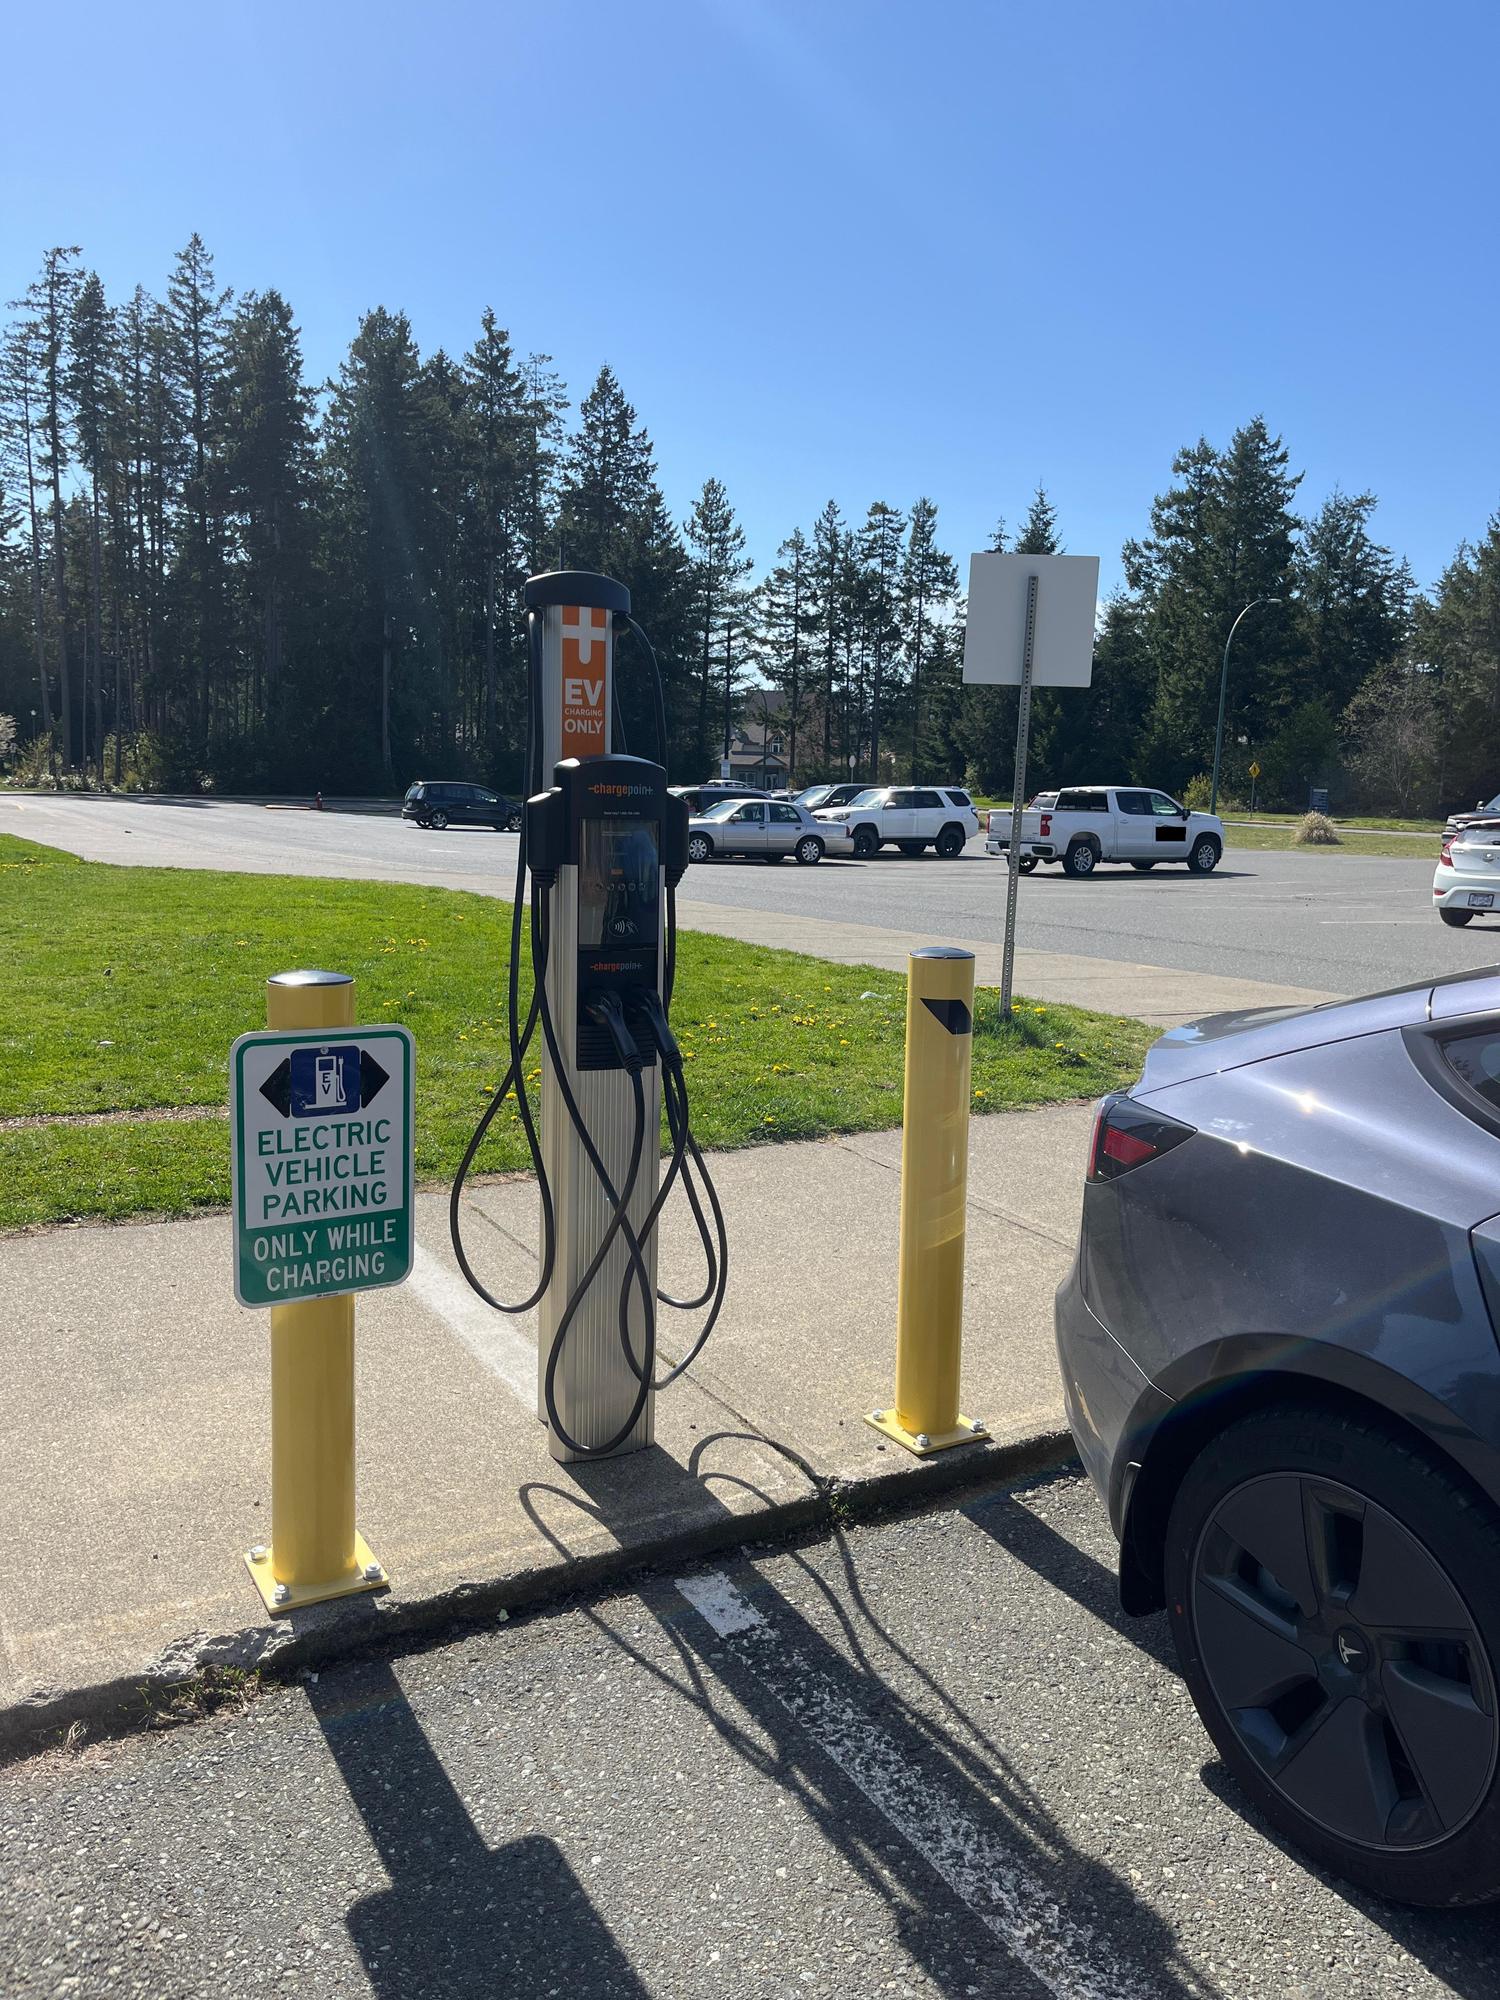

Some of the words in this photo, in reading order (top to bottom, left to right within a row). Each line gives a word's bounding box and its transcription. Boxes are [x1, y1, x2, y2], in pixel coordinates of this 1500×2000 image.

[564, 678, 603, 706] EV
[564, 707, 603, 717] CHARGING
[564, 718, 603, 735] ONLY
[258, 1119, 392, 1157] ELECTRIC
[265, 1150, 386, 1187] VEHICLE
[263, 1181, 388, 1220] PARKING
[253, 1229, 318, 1263] ONLY
[327, 1218, 397, 1251] WHILE
[266, 1251, 386, 1293] CHARGING
